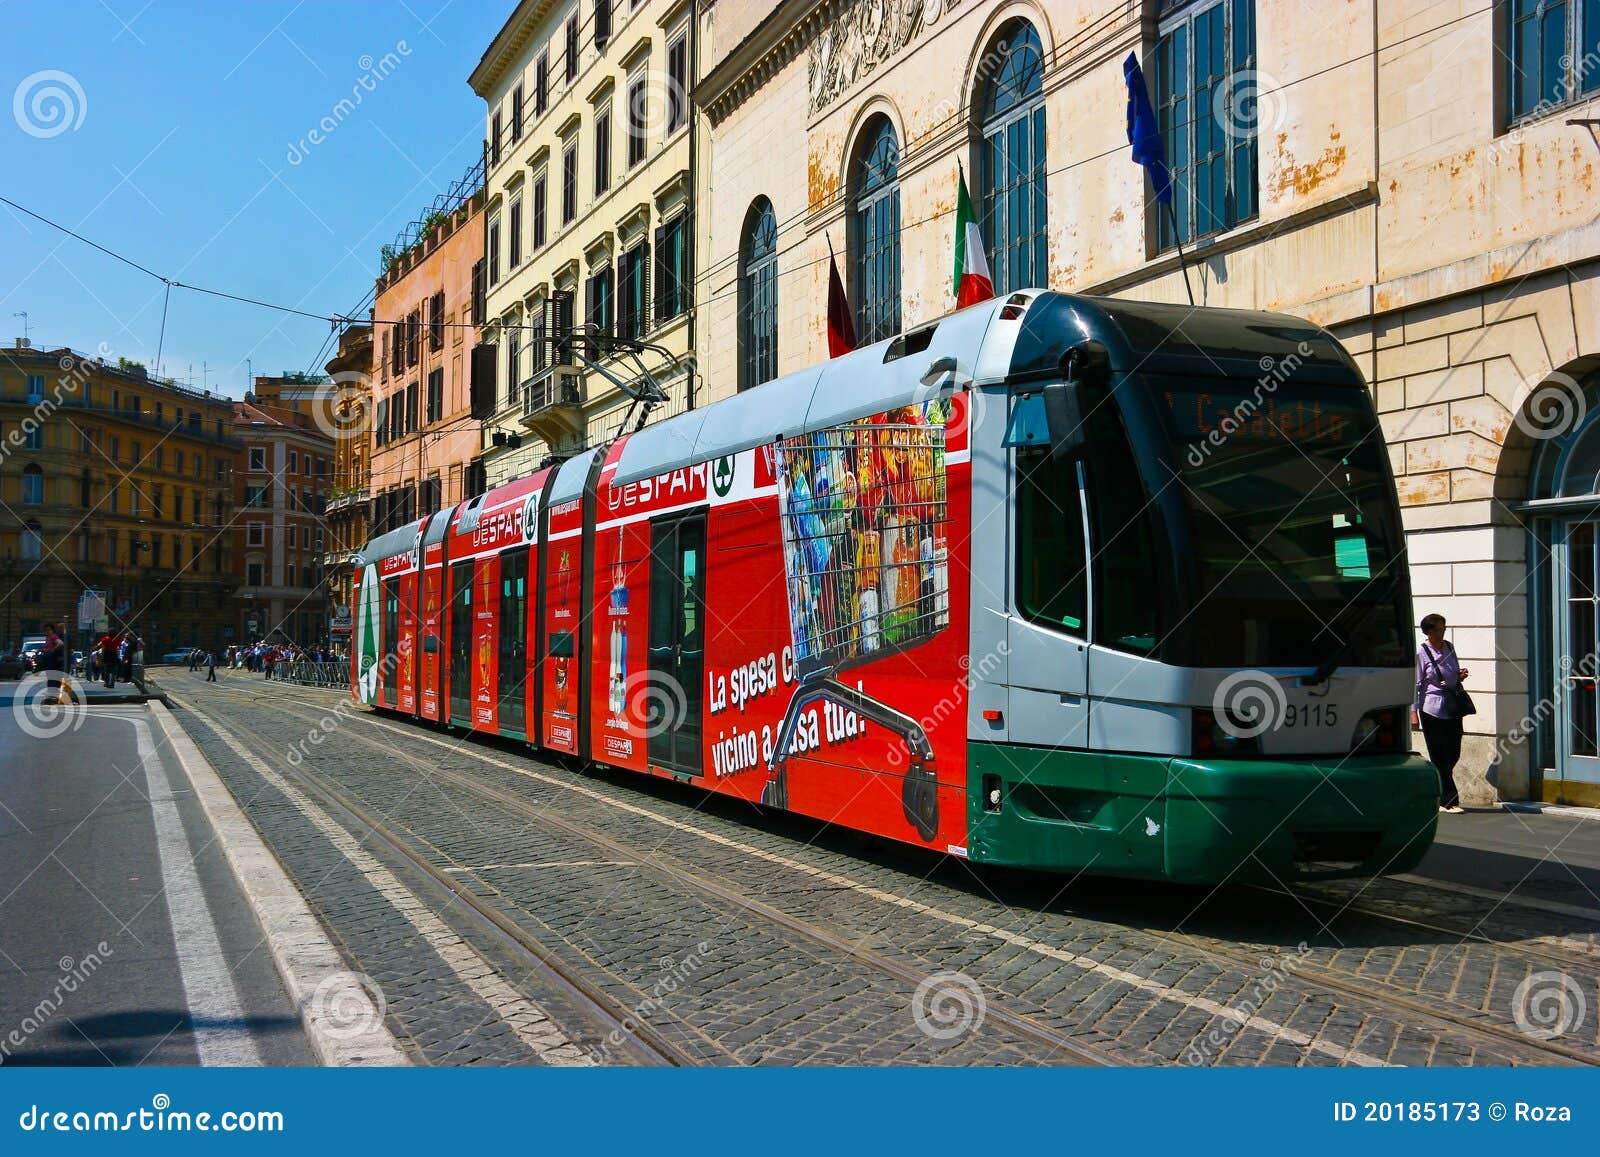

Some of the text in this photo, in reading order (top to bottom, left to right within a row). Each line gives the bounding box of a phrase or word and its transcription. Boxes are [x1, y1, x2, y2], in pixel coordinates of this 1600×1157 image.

[709, 671, 726, 713] La
[731, 652, 776, 711] spesa
[1284, 703, 1338, 728] 9115
[711, 726, 758, 777] vicino
[762, 724, 773, 762] a
